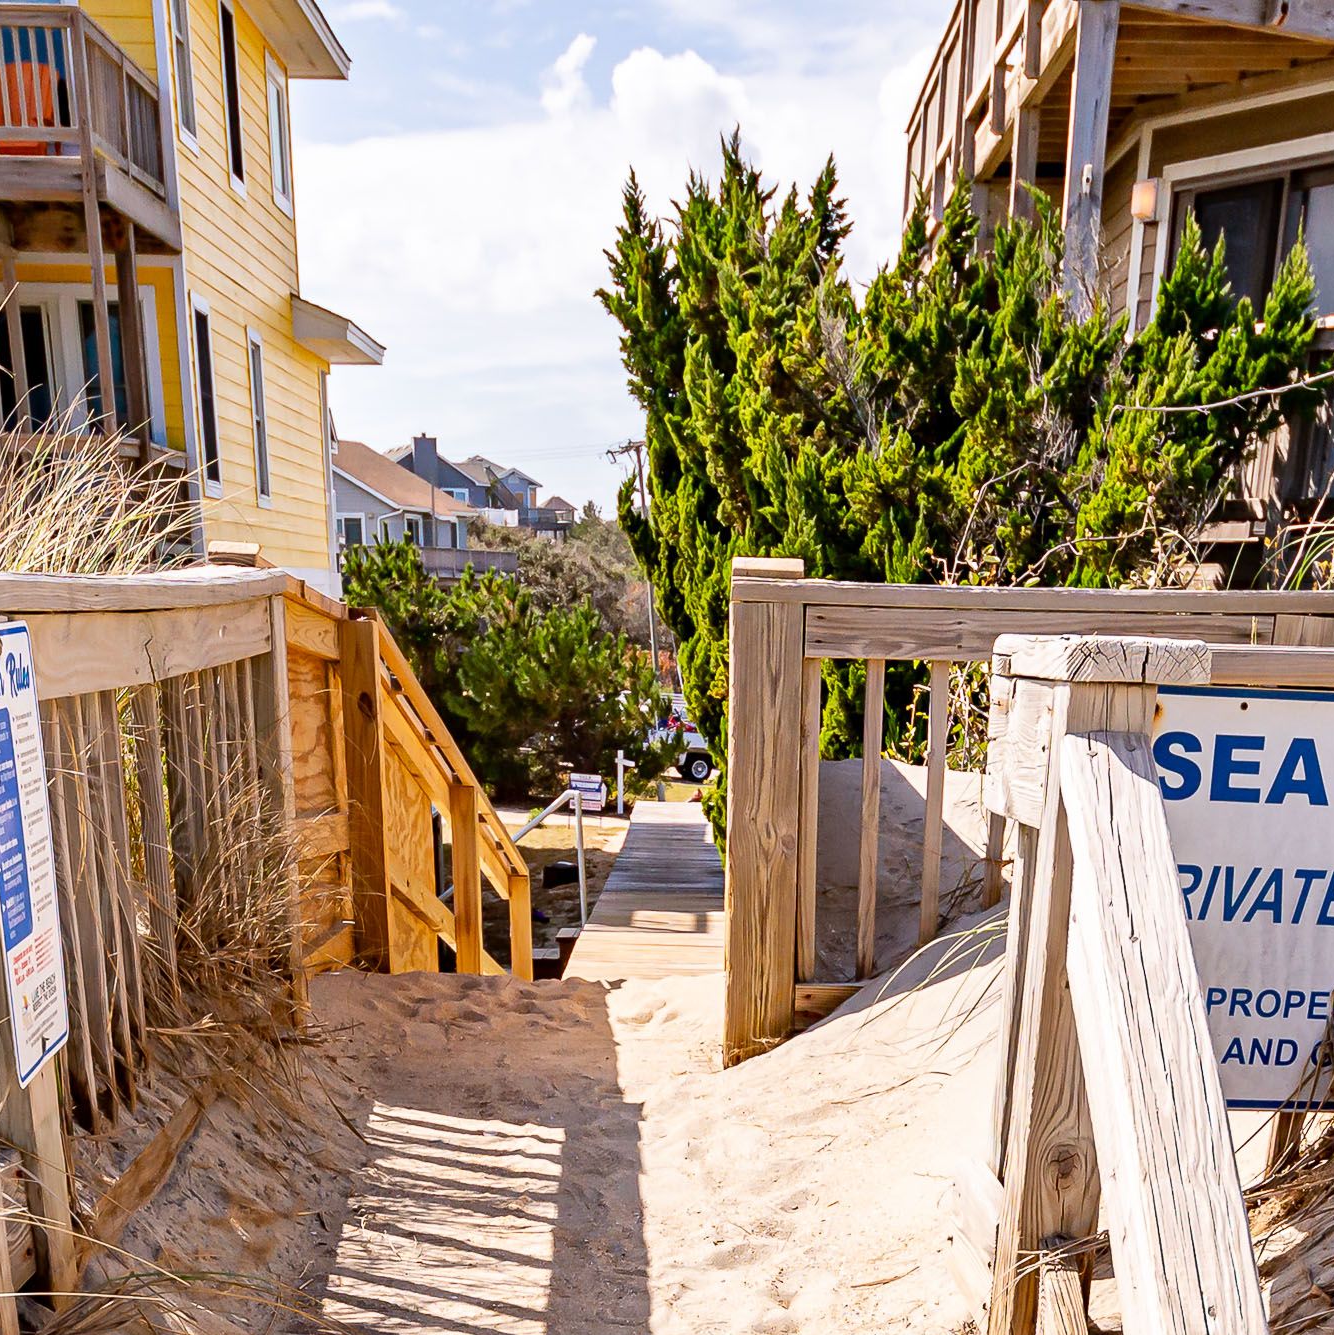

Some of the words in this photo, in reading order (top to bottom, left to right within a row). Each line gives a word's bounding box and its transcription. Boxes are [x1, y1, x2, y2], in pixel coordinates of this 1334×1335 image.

[6, 652, 29, 698] Rules
[1152, 731, 1329, 806] SEA
[1221, 1037, 1299, 1067] AND
